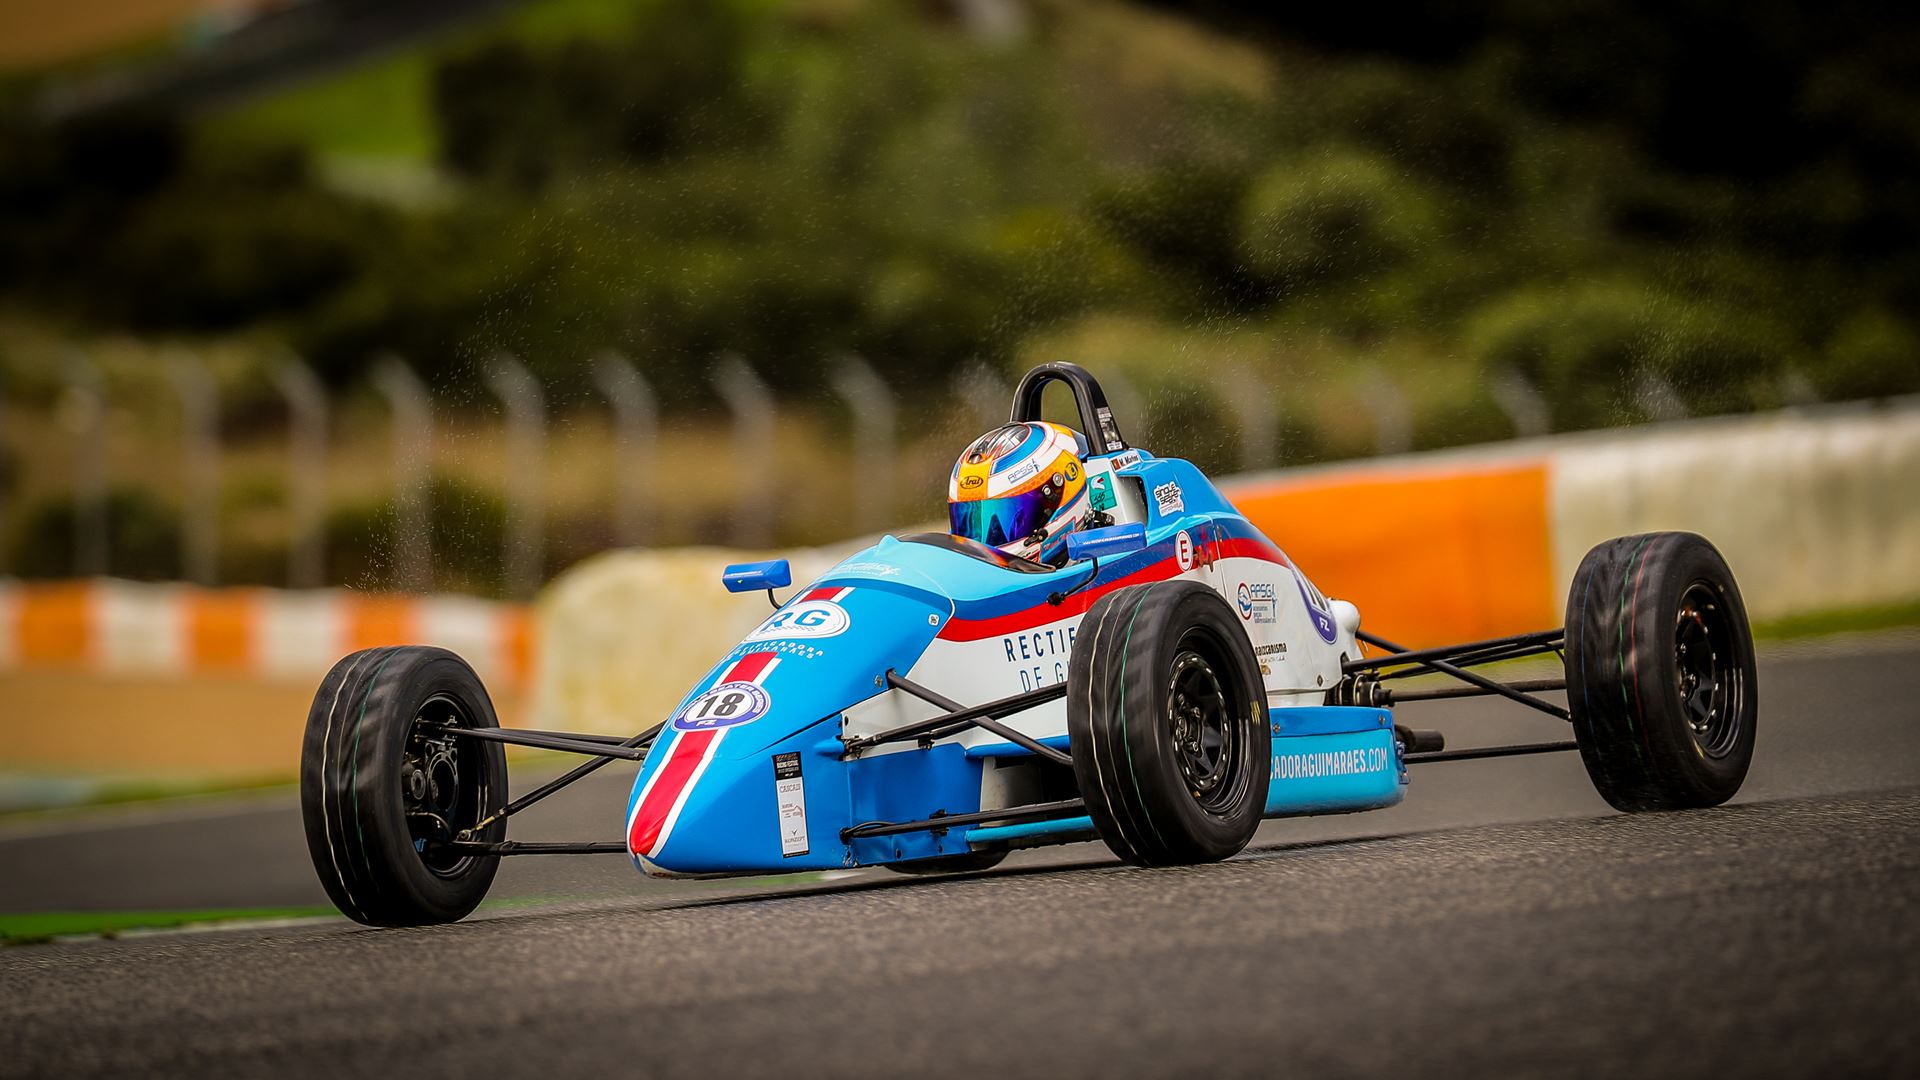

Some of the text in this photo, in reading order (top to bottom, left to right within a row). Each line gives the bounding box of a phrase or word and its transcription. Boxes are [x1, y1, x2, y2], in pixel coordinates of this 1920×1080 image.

[962, 477, 981, 486] Arai
[1180, 540, 1189, 563] E
[760, 609, 831, 632] RG
[1319, 616, 1330, 632] FZ
[696, 692, 745, 718] 18
